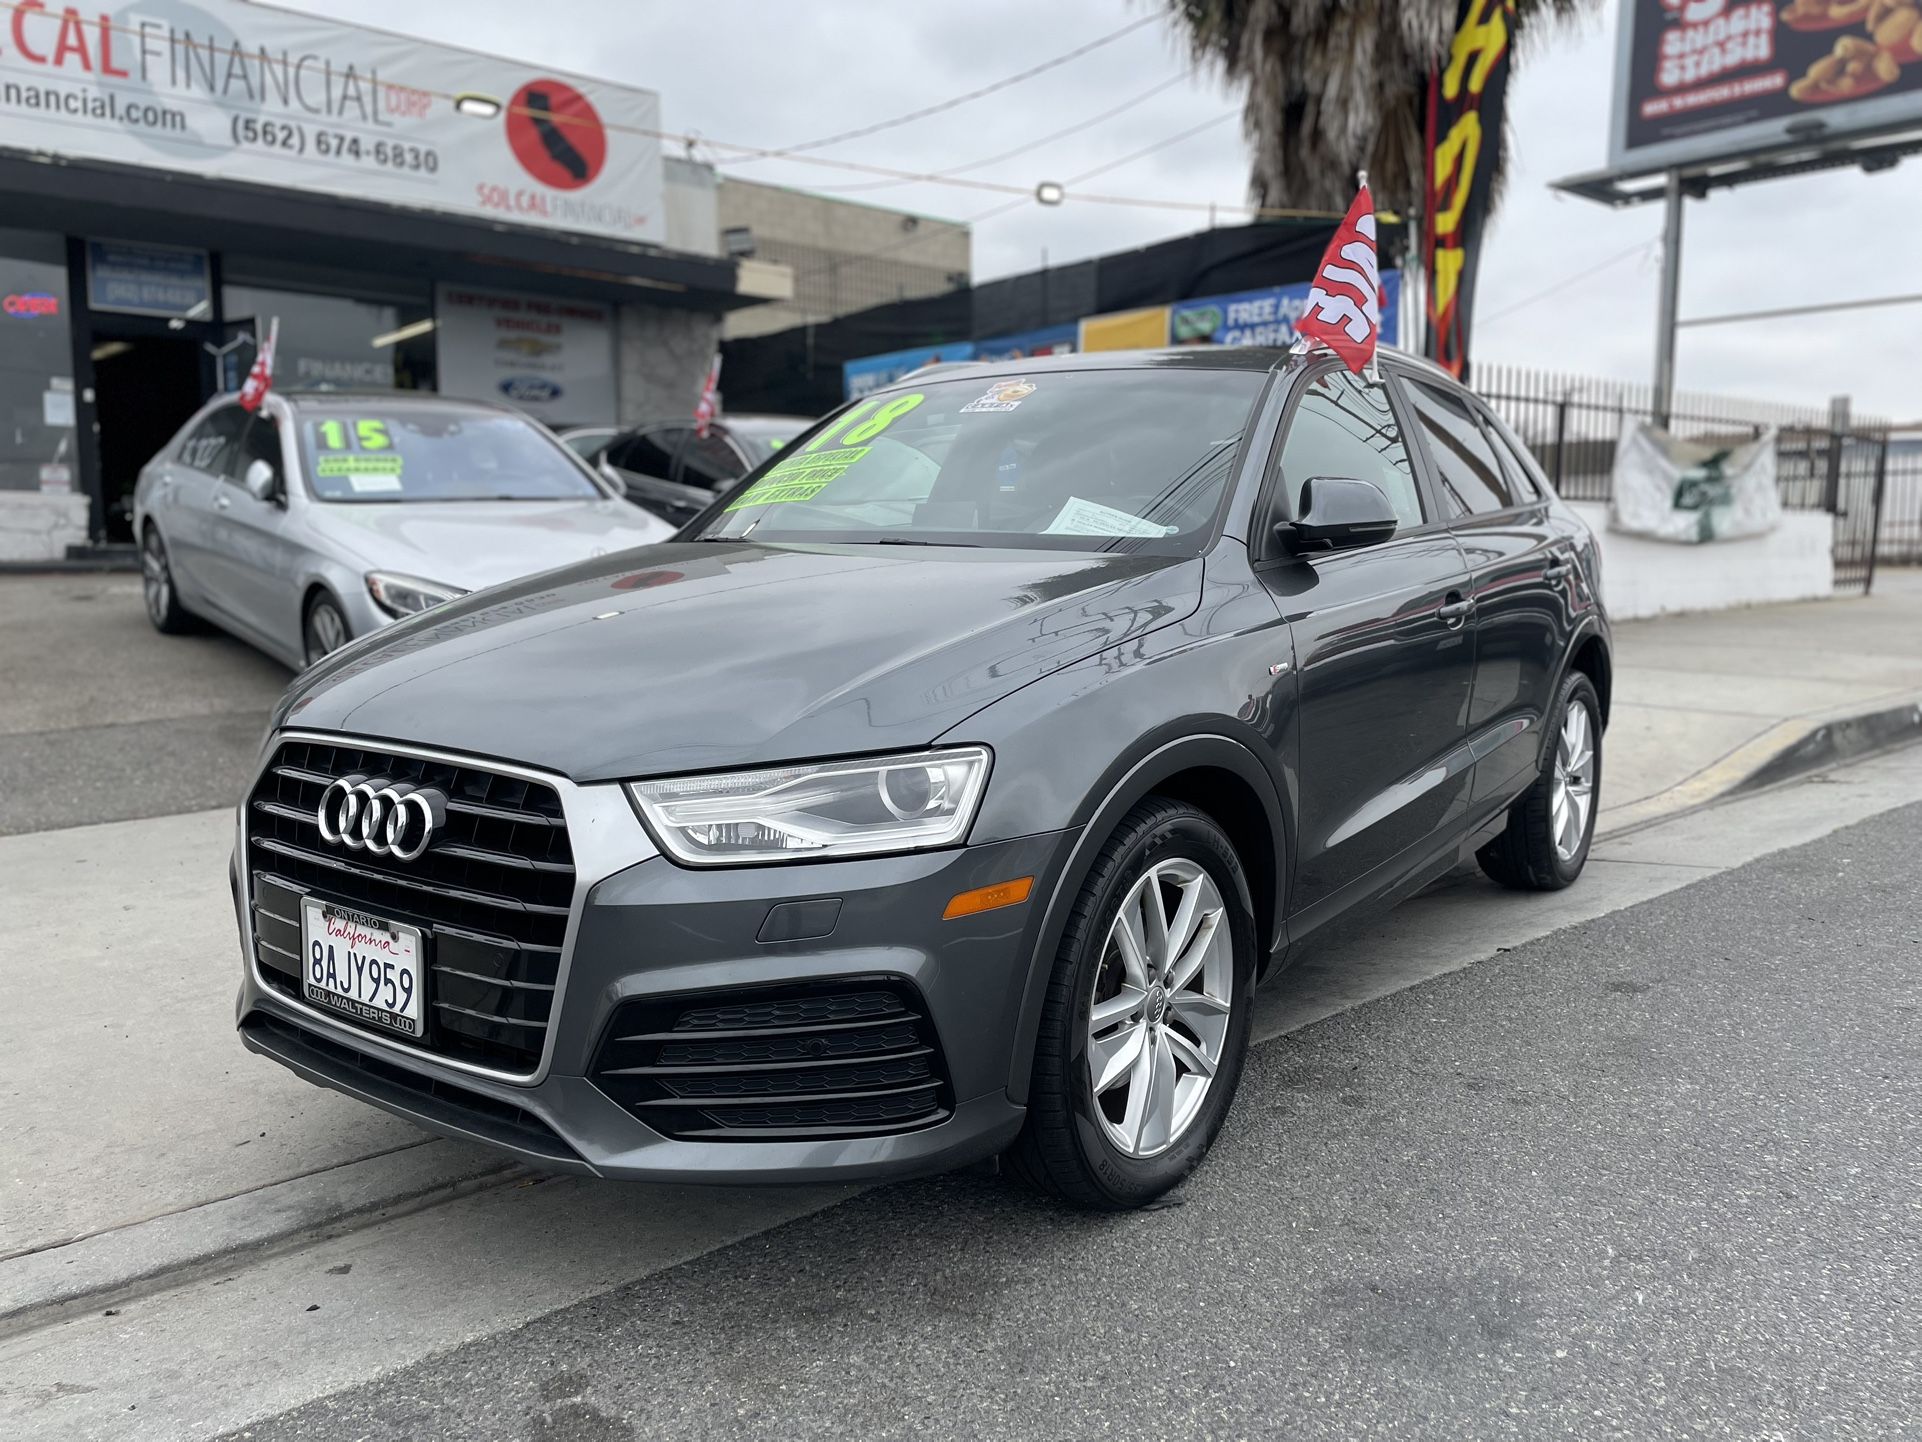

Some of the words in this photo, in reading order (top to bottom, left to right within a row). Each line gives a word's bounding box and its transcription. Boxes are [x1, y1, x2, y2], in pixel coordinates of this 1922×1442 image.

[1662, 2, 1773, 56] SNACK
[1659, 31, 1770, 87] STASH
[231, 113, 306, 155] (562)
[315, 130, 439, 174] 674-6830
[1226, 299, 1277, 328] FREE
[319, 419, 390, 450] 15
[805, 393, 925, 452] 18
[327, 917, 399, 955] California
[334, 909, 380, 929] ONTARIO
[312, 940, 413, 1013] 8AJY959
[330, 994, 390, 1024] WALTER'S
